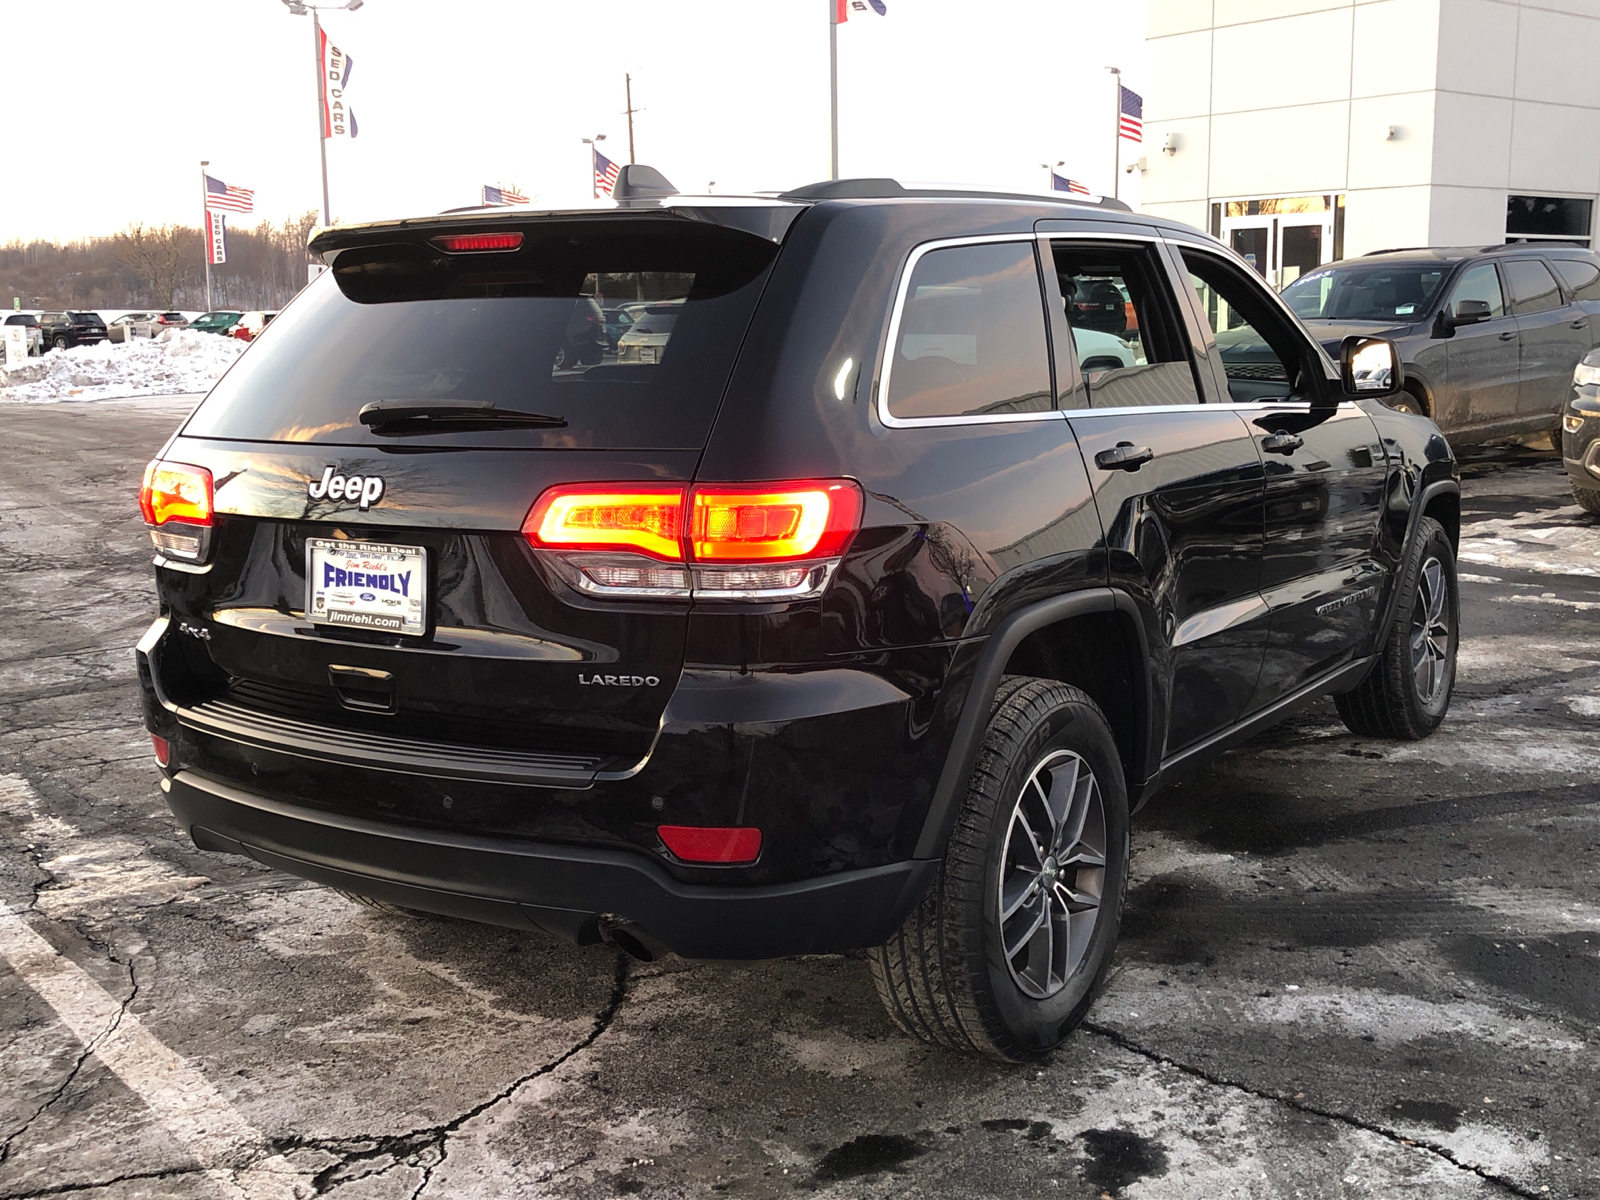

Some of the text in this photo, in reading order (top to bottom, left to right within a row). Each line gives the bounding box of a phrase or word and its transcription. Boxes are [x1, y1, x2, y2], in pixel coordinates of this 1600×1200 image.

[330, 46, 345, 135] SED CARS
[213, 213, 223, 262] USED CARS
[308, 466, 385, 509] Jeep
[315, 540, 416, 555] Get the Riehl Deal
[345, 560, 388, 571] Jim Riehl's
[324, 561, 412, 597] FRIENDLY
[329, 611, 400, 628] jimriehl.com
[578, 673, 660, 687] LAREDO
